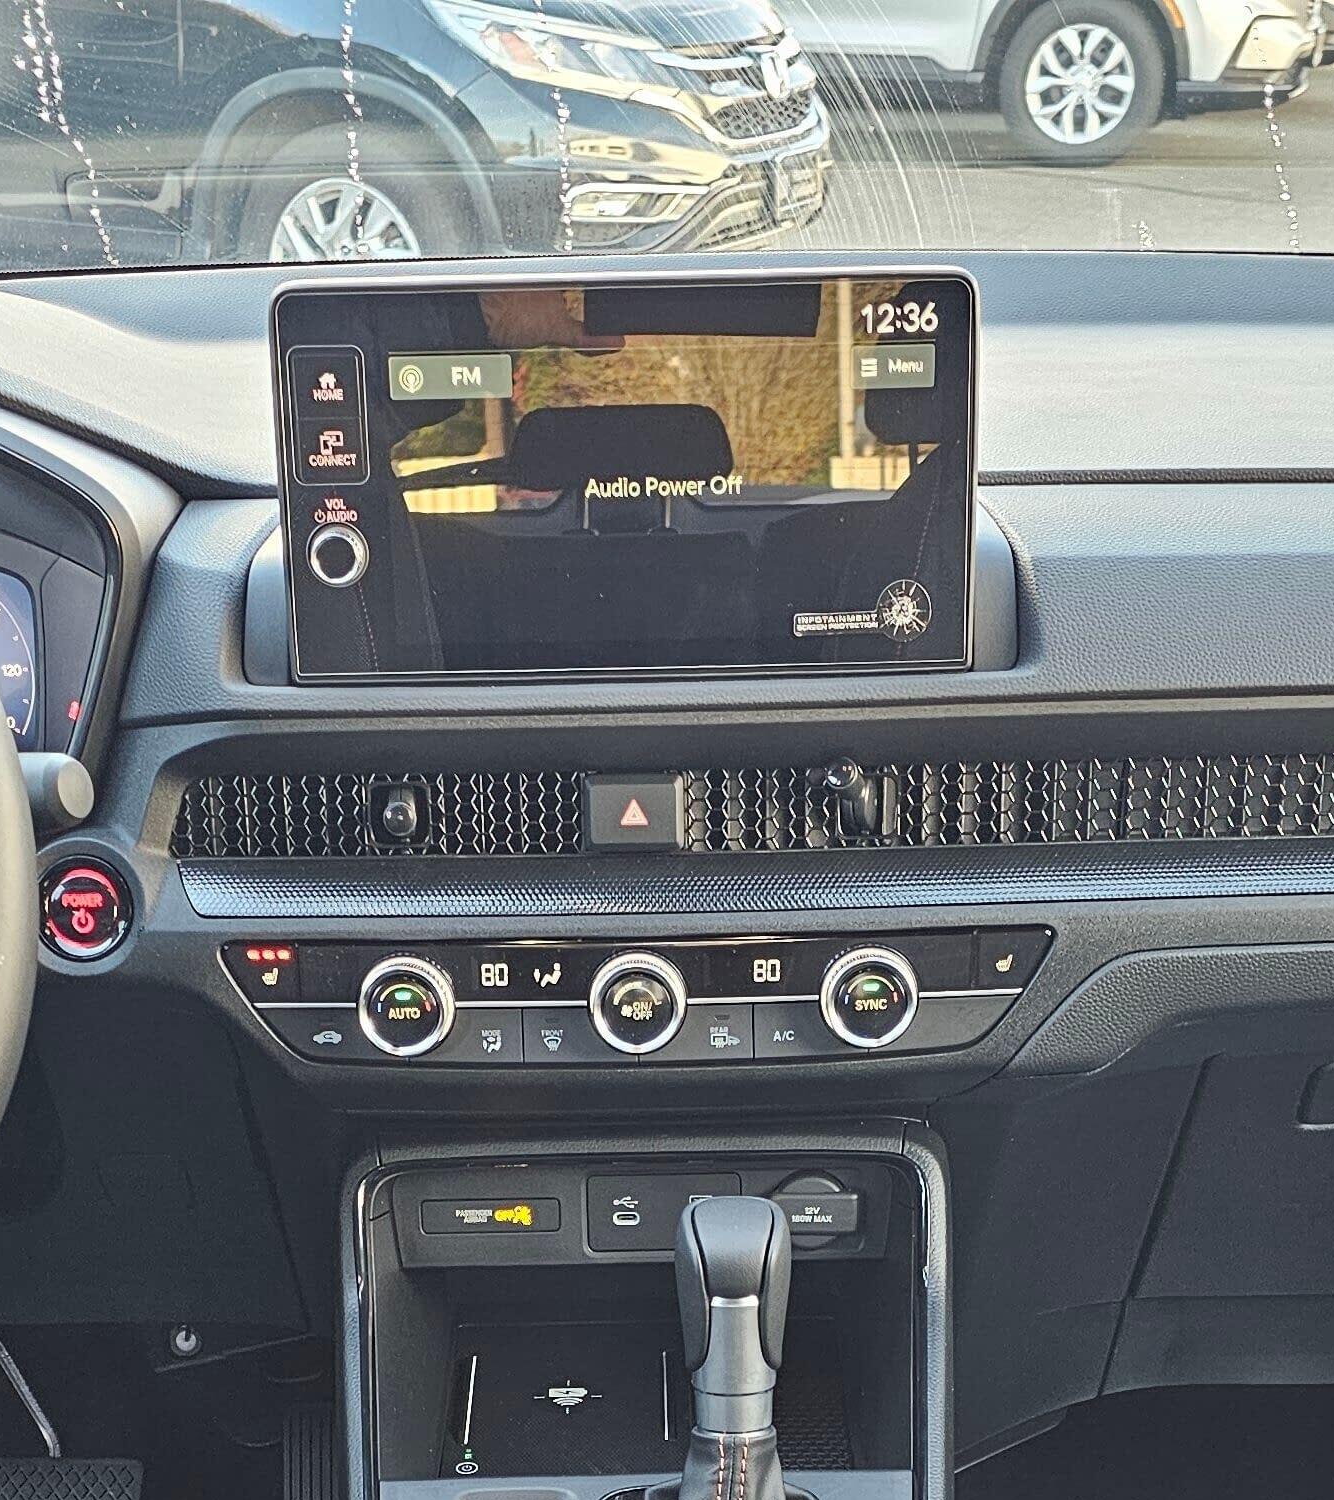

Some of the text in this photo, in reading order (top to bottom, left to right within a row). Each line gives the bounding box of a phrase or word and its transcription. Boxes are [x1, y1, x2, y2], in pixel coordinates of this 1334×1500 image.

[861, 302, 940, 333] 12:36
[888, 358, 925, 374] Menu
[450, 366, 482, 387] FM
[312, 388, 344, 401] HOME
[308, 454, 357, 467] CONNECT
[584, 475, 743, 499] Audio Power Off
[324, 498, 347, 510] VOL
[326, 511, 358, 523] AUDIO
[797, 613, 879, 625] INFOTAINMENT
[0, 663, 23, 678] 120
[480, 962, 509, 987] 80
[752, 958, 781, 983] 80
[854, 999, 888, 1012] SYNC
[387, 1007, 421, 1020] AUTO
[540, 1029, 564, 1037] FRONT
[772, 1030, 795, 1042] A/C
[804, 1206, 821, 1215] 12V
[813, 1214, 833, 1223] MAX
